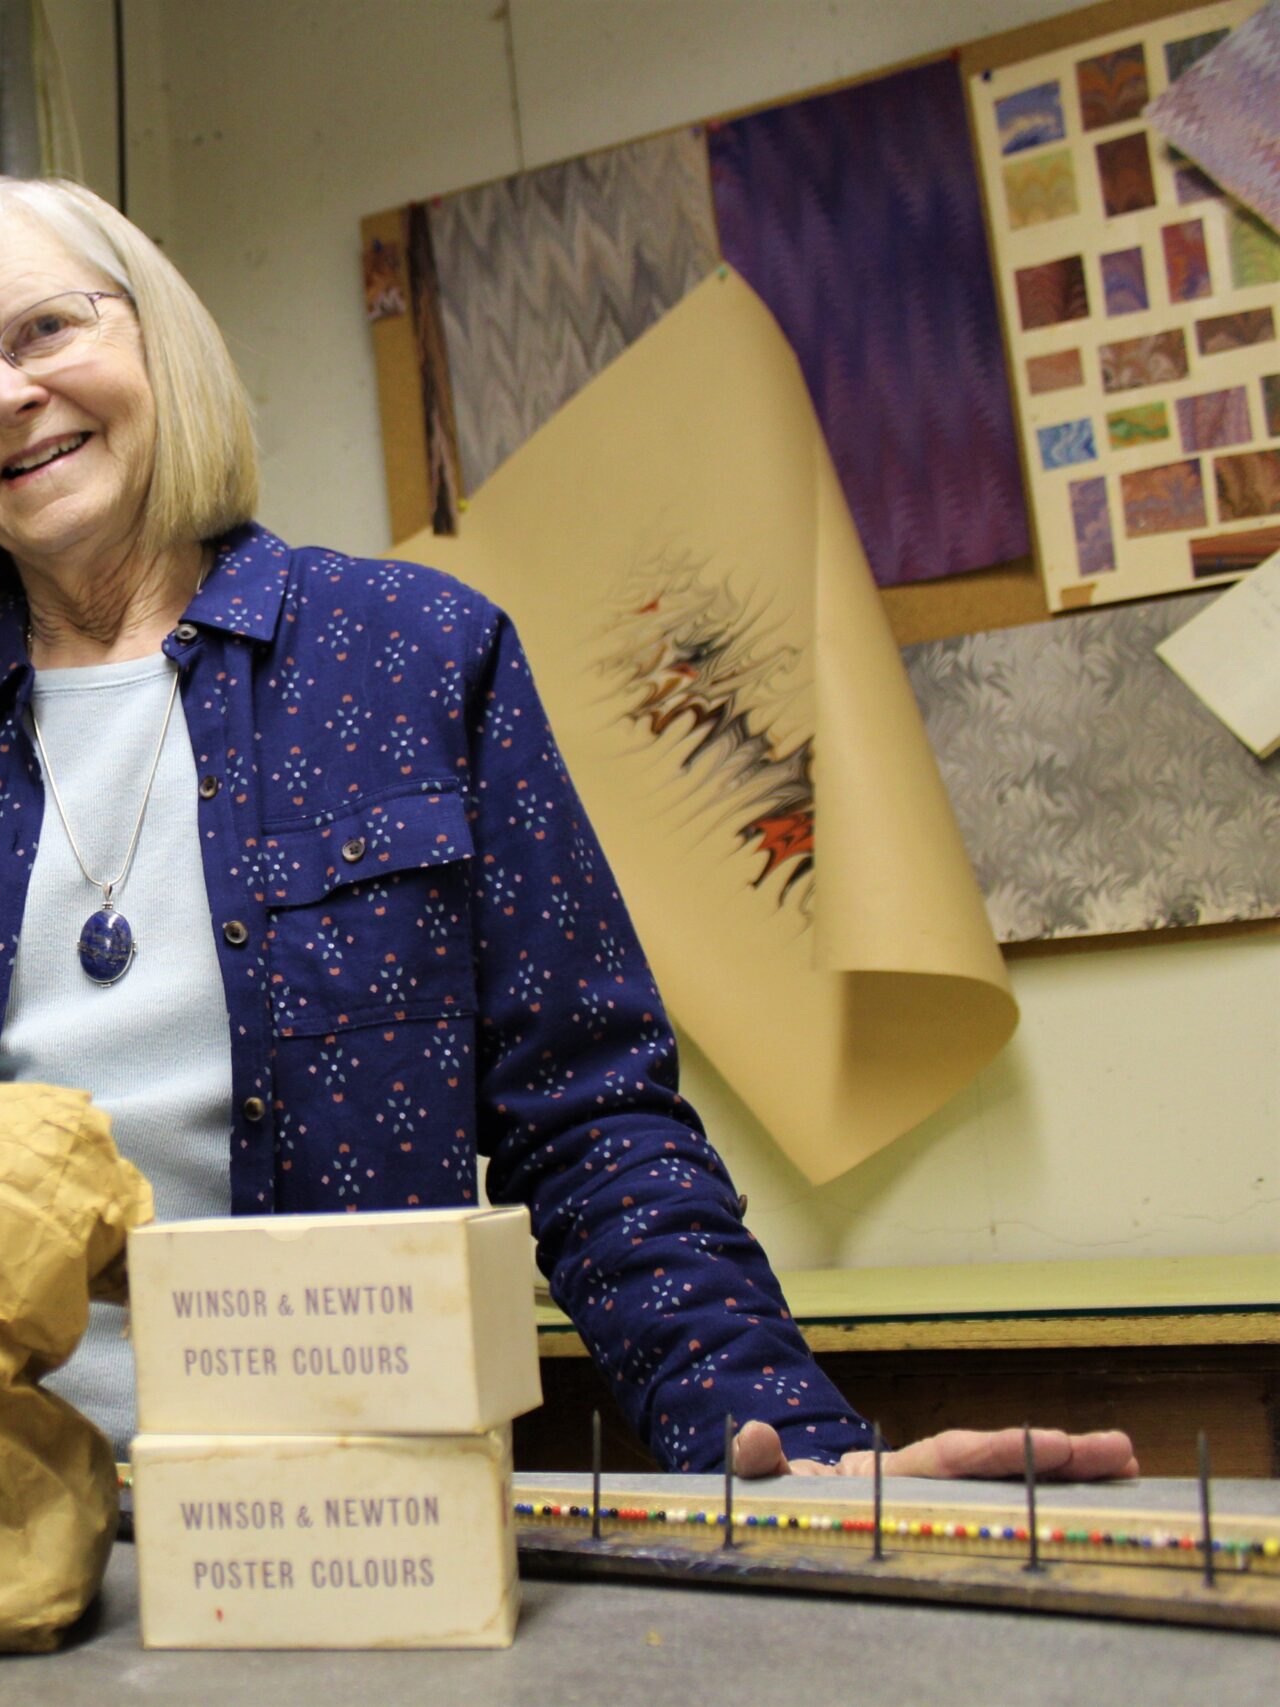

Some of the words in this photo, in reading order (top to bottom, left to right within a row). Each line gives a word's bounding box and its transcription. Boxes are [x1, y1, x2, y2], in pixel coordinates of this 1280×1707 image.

[173, 1288, 268, 1318] WINSOR
[278, 1294, 295, 1316] &
[305, 1285, 414, 1315] NEWTON
[184, 1348, 277, 1376] POSTER
[293, 1346, 410, 1375] COLOURS
[181, 1501, 285, 1531] WINSOR
[297, 1506, 314, 1529] &
[325, 1497, 440, 1528] NEWTON
[194, 1561, 294, 1590] POSTER
[311, 1558, 436, 1589] COLOURS
